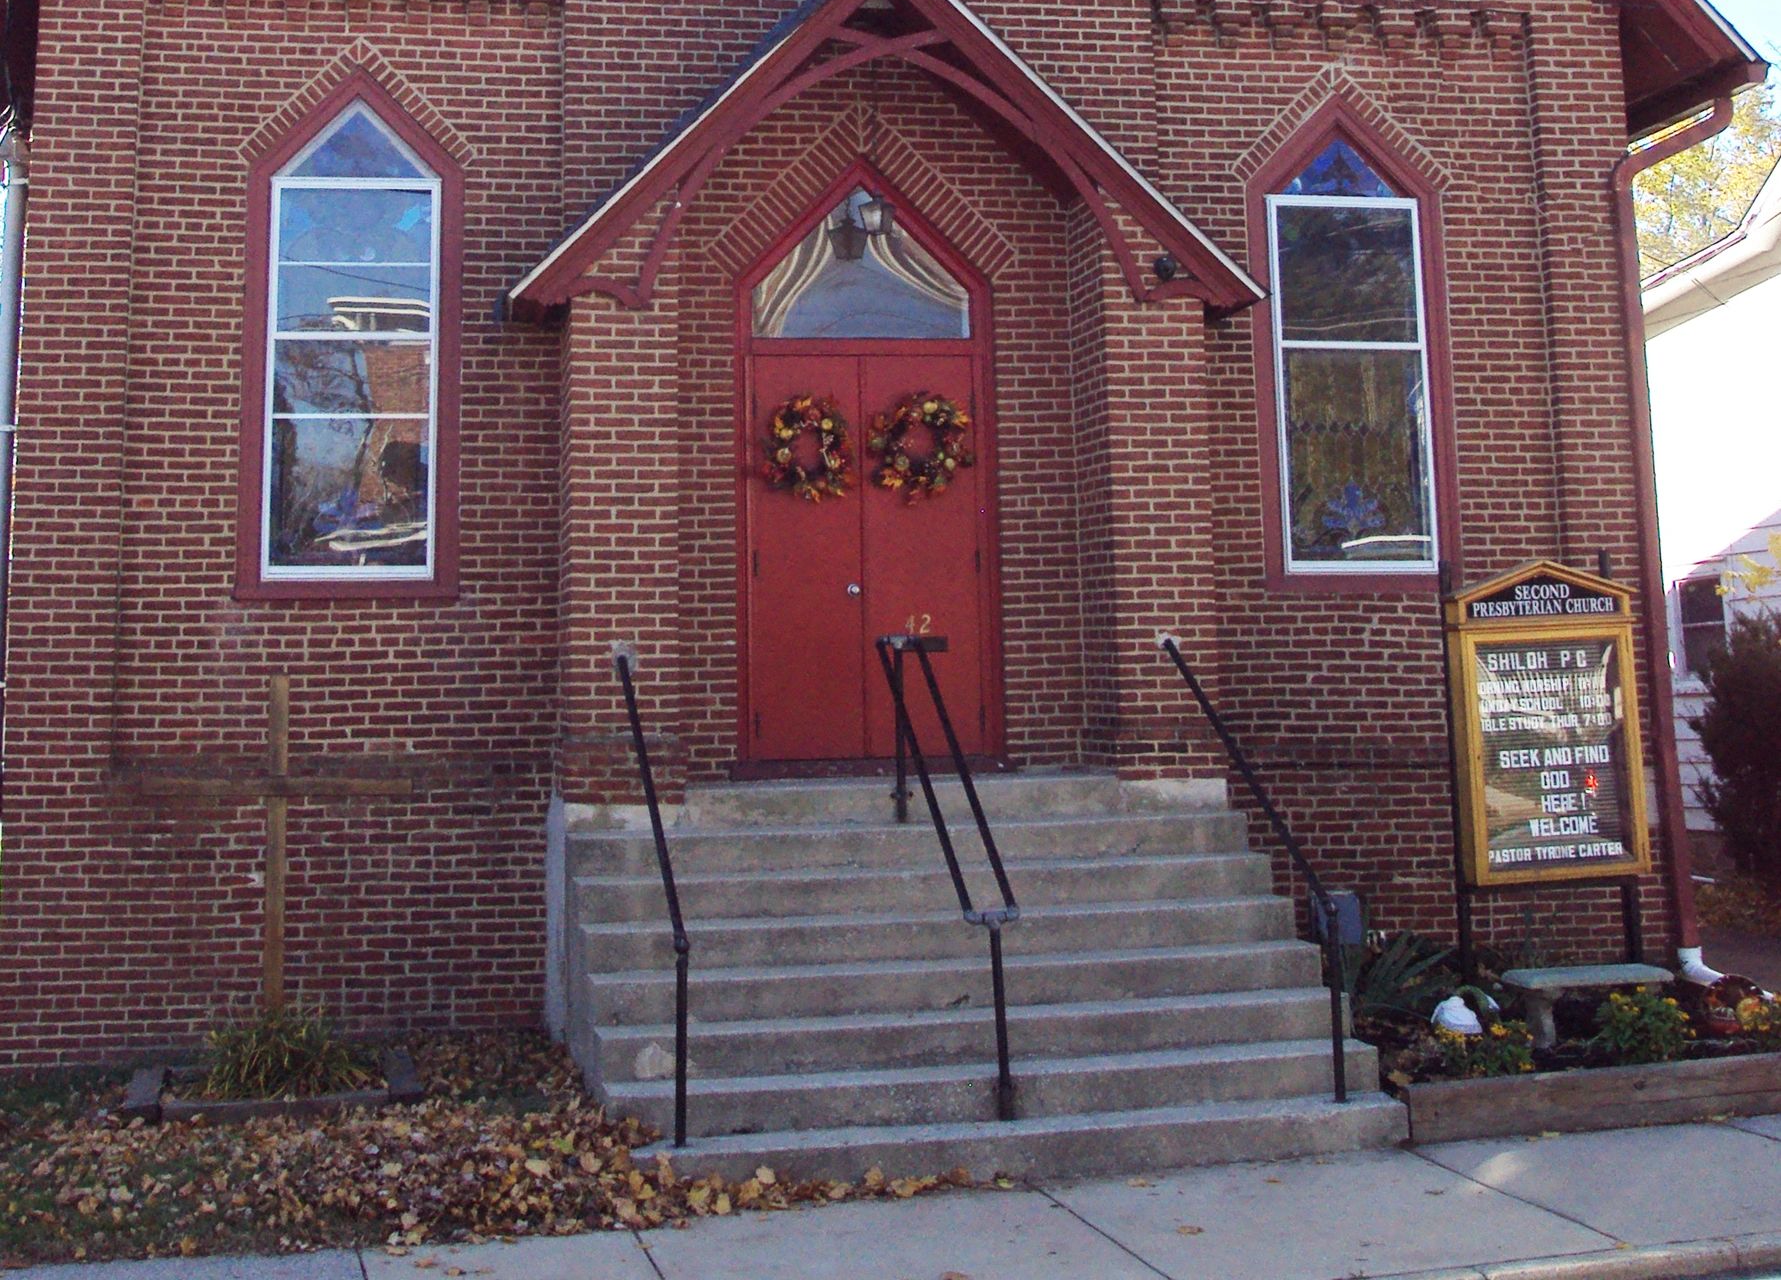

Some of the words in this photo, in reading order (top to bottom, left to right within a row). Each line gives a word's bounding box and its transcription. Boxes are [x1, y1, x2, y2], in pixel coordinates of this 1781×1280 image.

[1515, 584, 1569, 600] SECOND
[1473, 599, 1562, 617] PRESBYTERIAN
[1565, 597, 1614, 613] CHURCH
[905, 614, 931, 634] 42
[1487, 651, 1549, 671] SHILOH
[1477, 680, 1519, 695] ORNING
[1520, 677, 1569, 694] WORSHIP
[1479, 697, 1518, 713] UNDAY
[1519, 696, 1563, 710] SCHOOL
[1580, 694, 1611, 708] 10:00
[1508, 716, 1545, 730] STUDY
[1551, 713, 1578, 728] THUR
[1583, 712, 1612, 726] 7:00
[1499, 748, 1540, 768] SEEK
[1544, 746, 1572, 766] AND
[1574, 744, 1610, 764] FIND
[1540, 770, 1570, 789] GOD
[1529, 816, 1599, 837] WELCOME
[1488, 847, 1532, 863] PASTOR
[1535, 845, 1576, 860] TYRONE
[1578, 841, 1623, 857] CARTER
